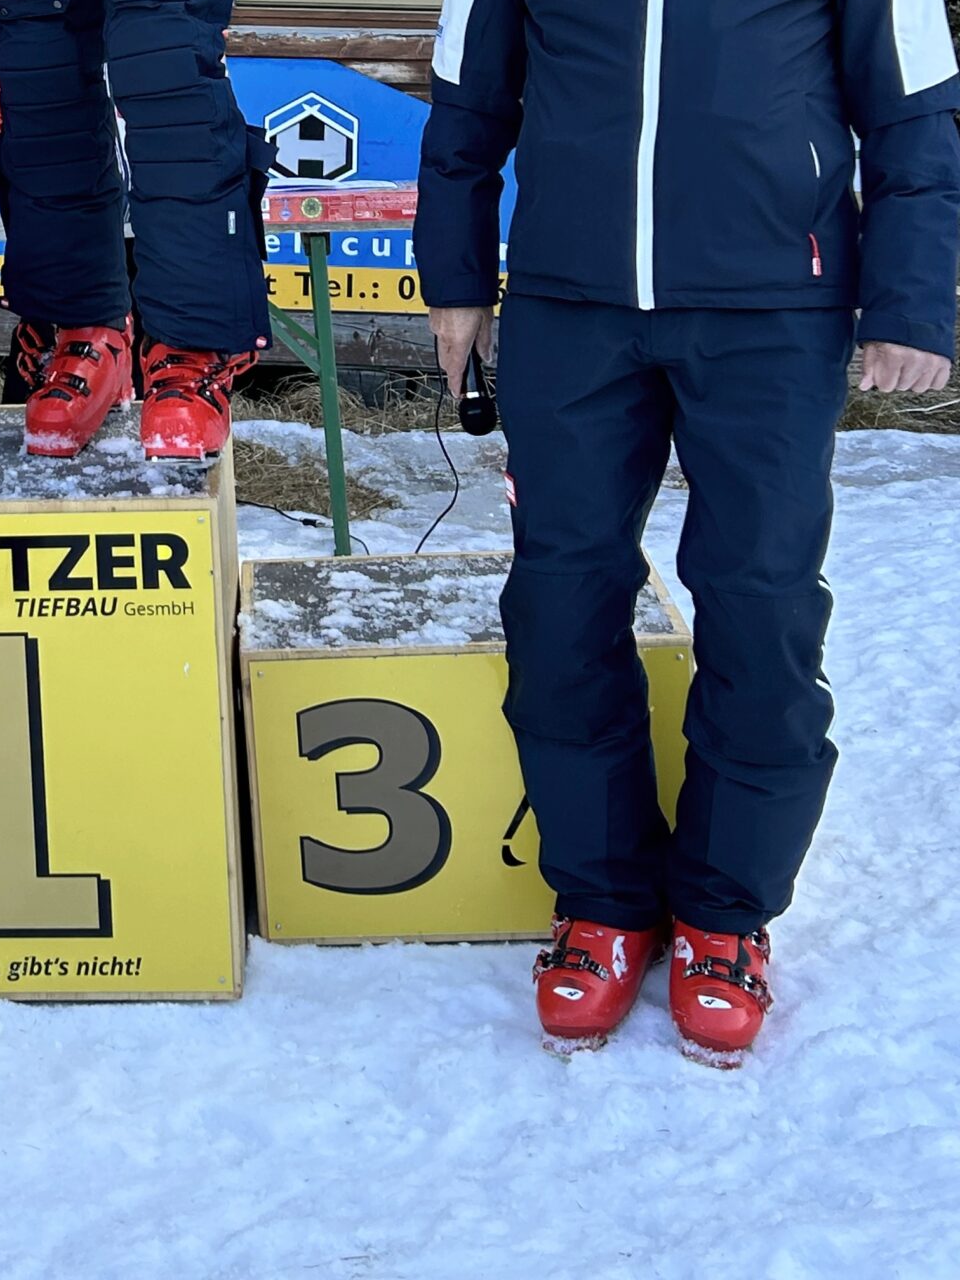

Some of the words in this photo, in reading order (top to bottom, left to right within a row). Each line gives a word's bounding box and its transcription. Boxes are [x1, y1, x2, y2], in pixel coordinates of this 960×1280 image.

[15, 597, 118, 618] TIEFBAU
[124, 601, 194, 617] GesmbH
[296, 698, 452, 895] 3
[76, 956, 142, 976] nicht!
